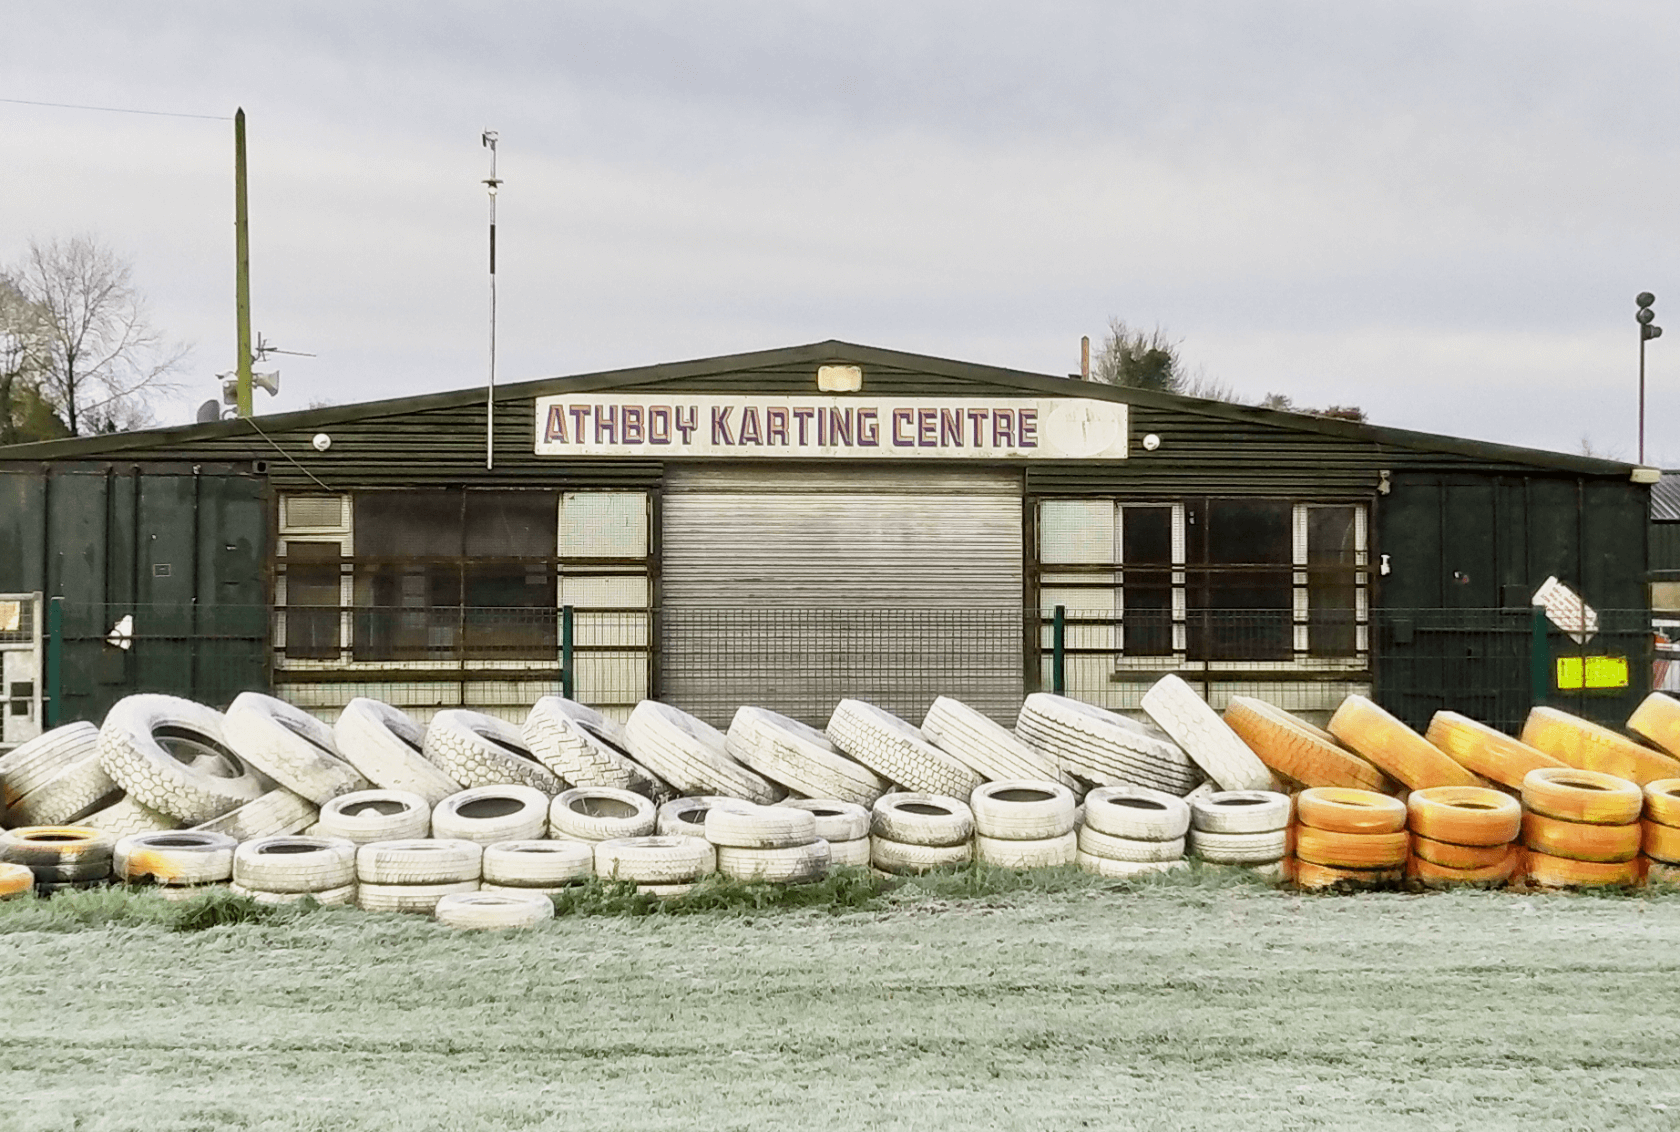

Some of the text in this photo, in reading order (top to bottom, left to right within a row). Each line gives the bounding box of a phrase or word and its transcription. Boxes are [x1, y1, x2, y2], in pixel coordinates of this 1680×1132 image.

[543, 404, 1038, 448] ATHBOY KARTING CENTRE
